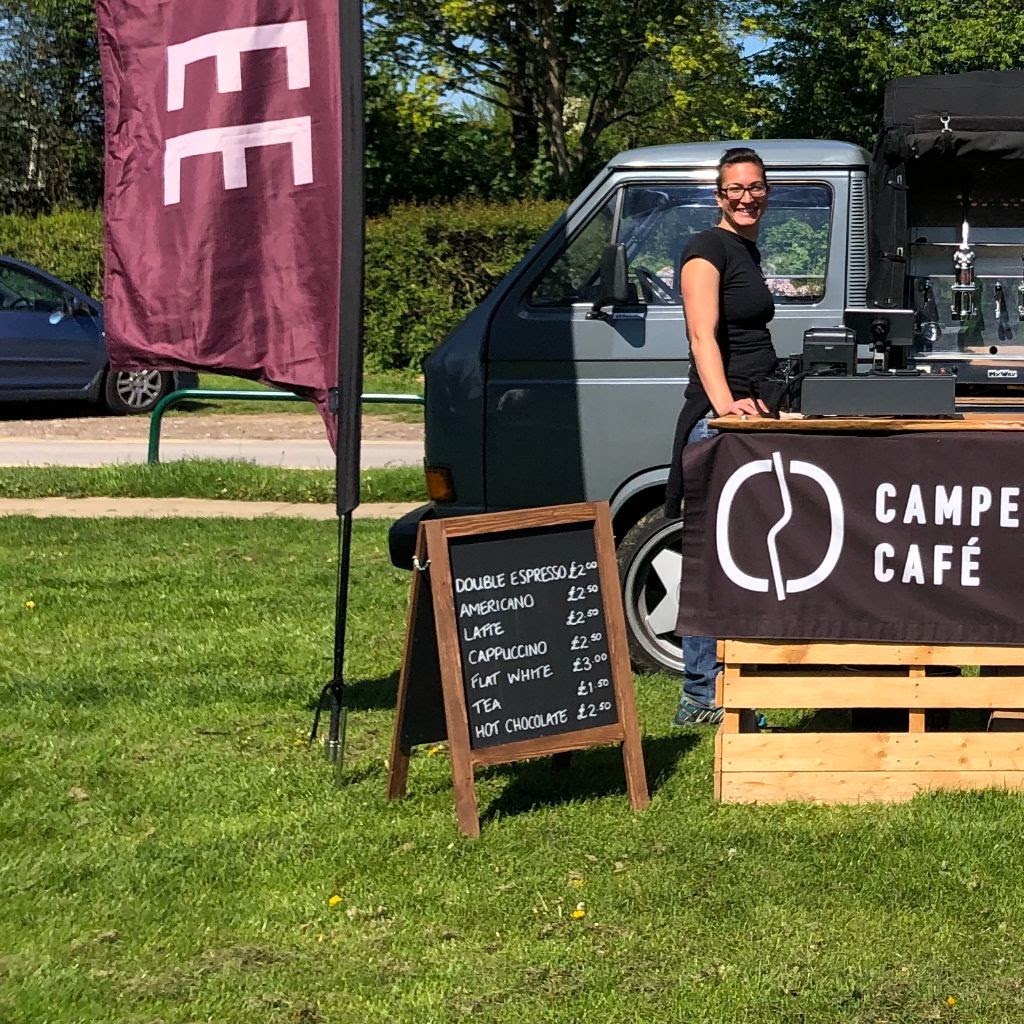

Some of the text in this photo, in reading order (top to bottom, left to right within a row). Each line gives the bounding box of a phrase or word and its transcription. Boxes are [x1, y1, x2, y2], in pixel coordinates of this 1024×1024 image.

[874, 536, 981, 587] CAFÉ
[455, 573, 506, 594] DOUBLE
[509, 564, 568, 587] ESPRESSO
[459, 593, 535, 618] AMERICANO
[463, 621, 505, 642] LATTE
[468, 640, 548, 665] CAPPUCCINO
[470, 670, 502, 690] FLAT
[507, 664, 554, 685] WHITE
[472, 698, 502, 715] TEA
[475, 719, 501, 739] HOT
[504, 708, 568, 734] CHOCOLATE
